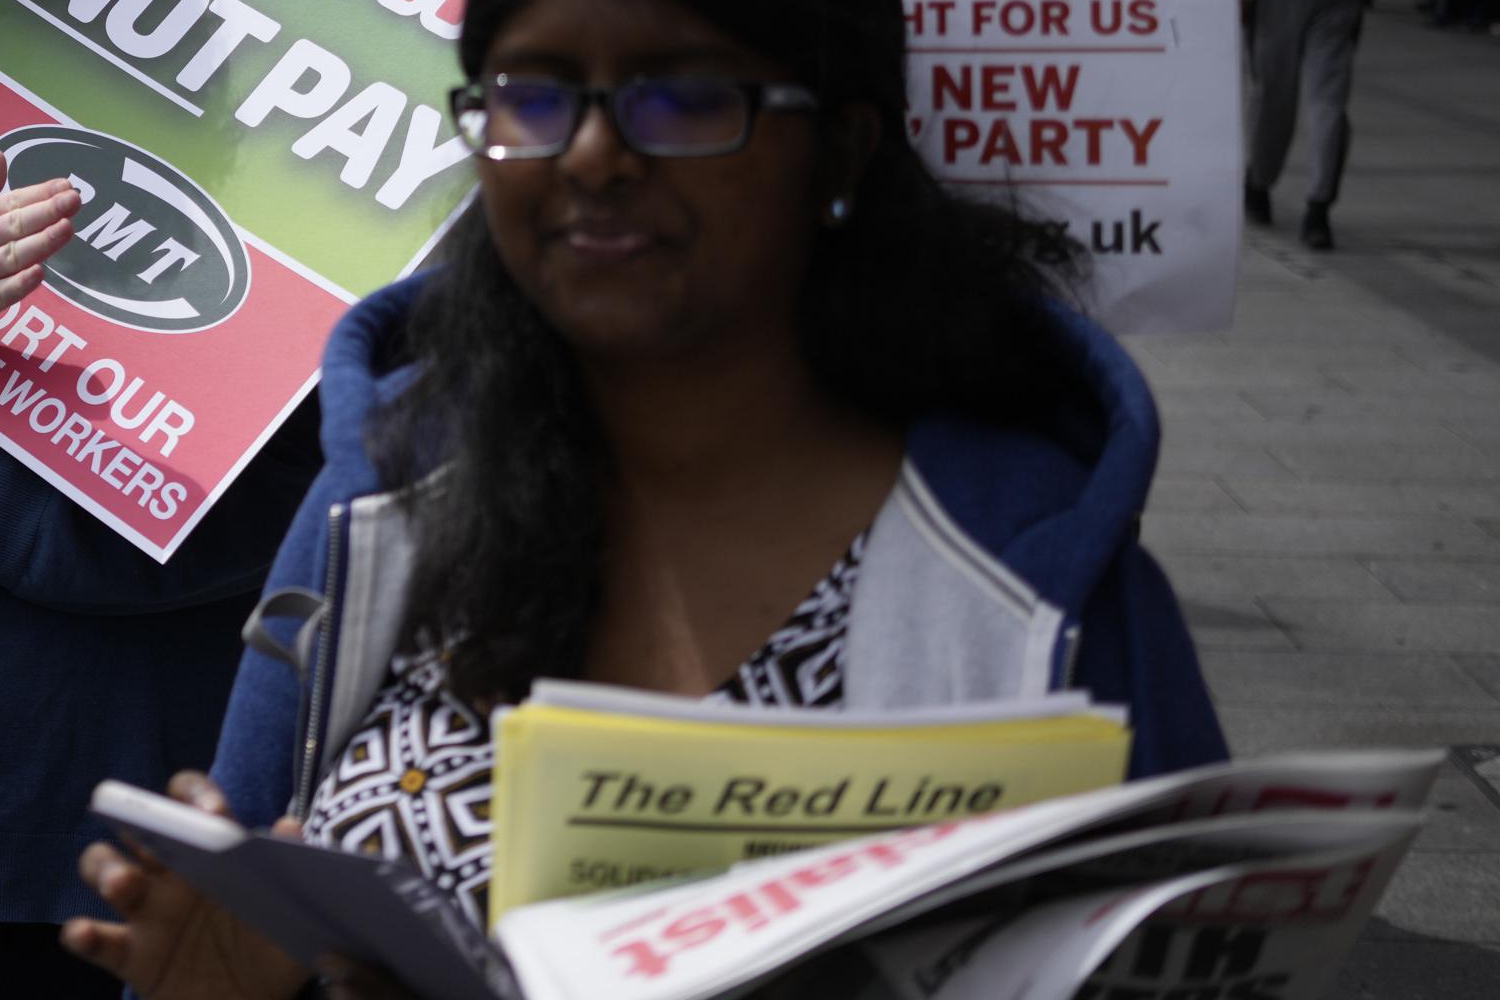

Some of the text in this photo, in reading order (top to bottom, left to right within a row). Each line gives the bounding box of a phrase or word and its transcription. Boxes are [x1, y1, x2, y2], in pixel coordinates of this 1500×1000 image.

[971, 0, 1071, 37] FOR
[932, 64, 1081, 112] NEW
[235, 38, 476, 210] PAY
[943, 118, 1163, 167] PARTY
[76, 358, 196, 459] OUR
[577, 770, 1007, 820] The Red Line
